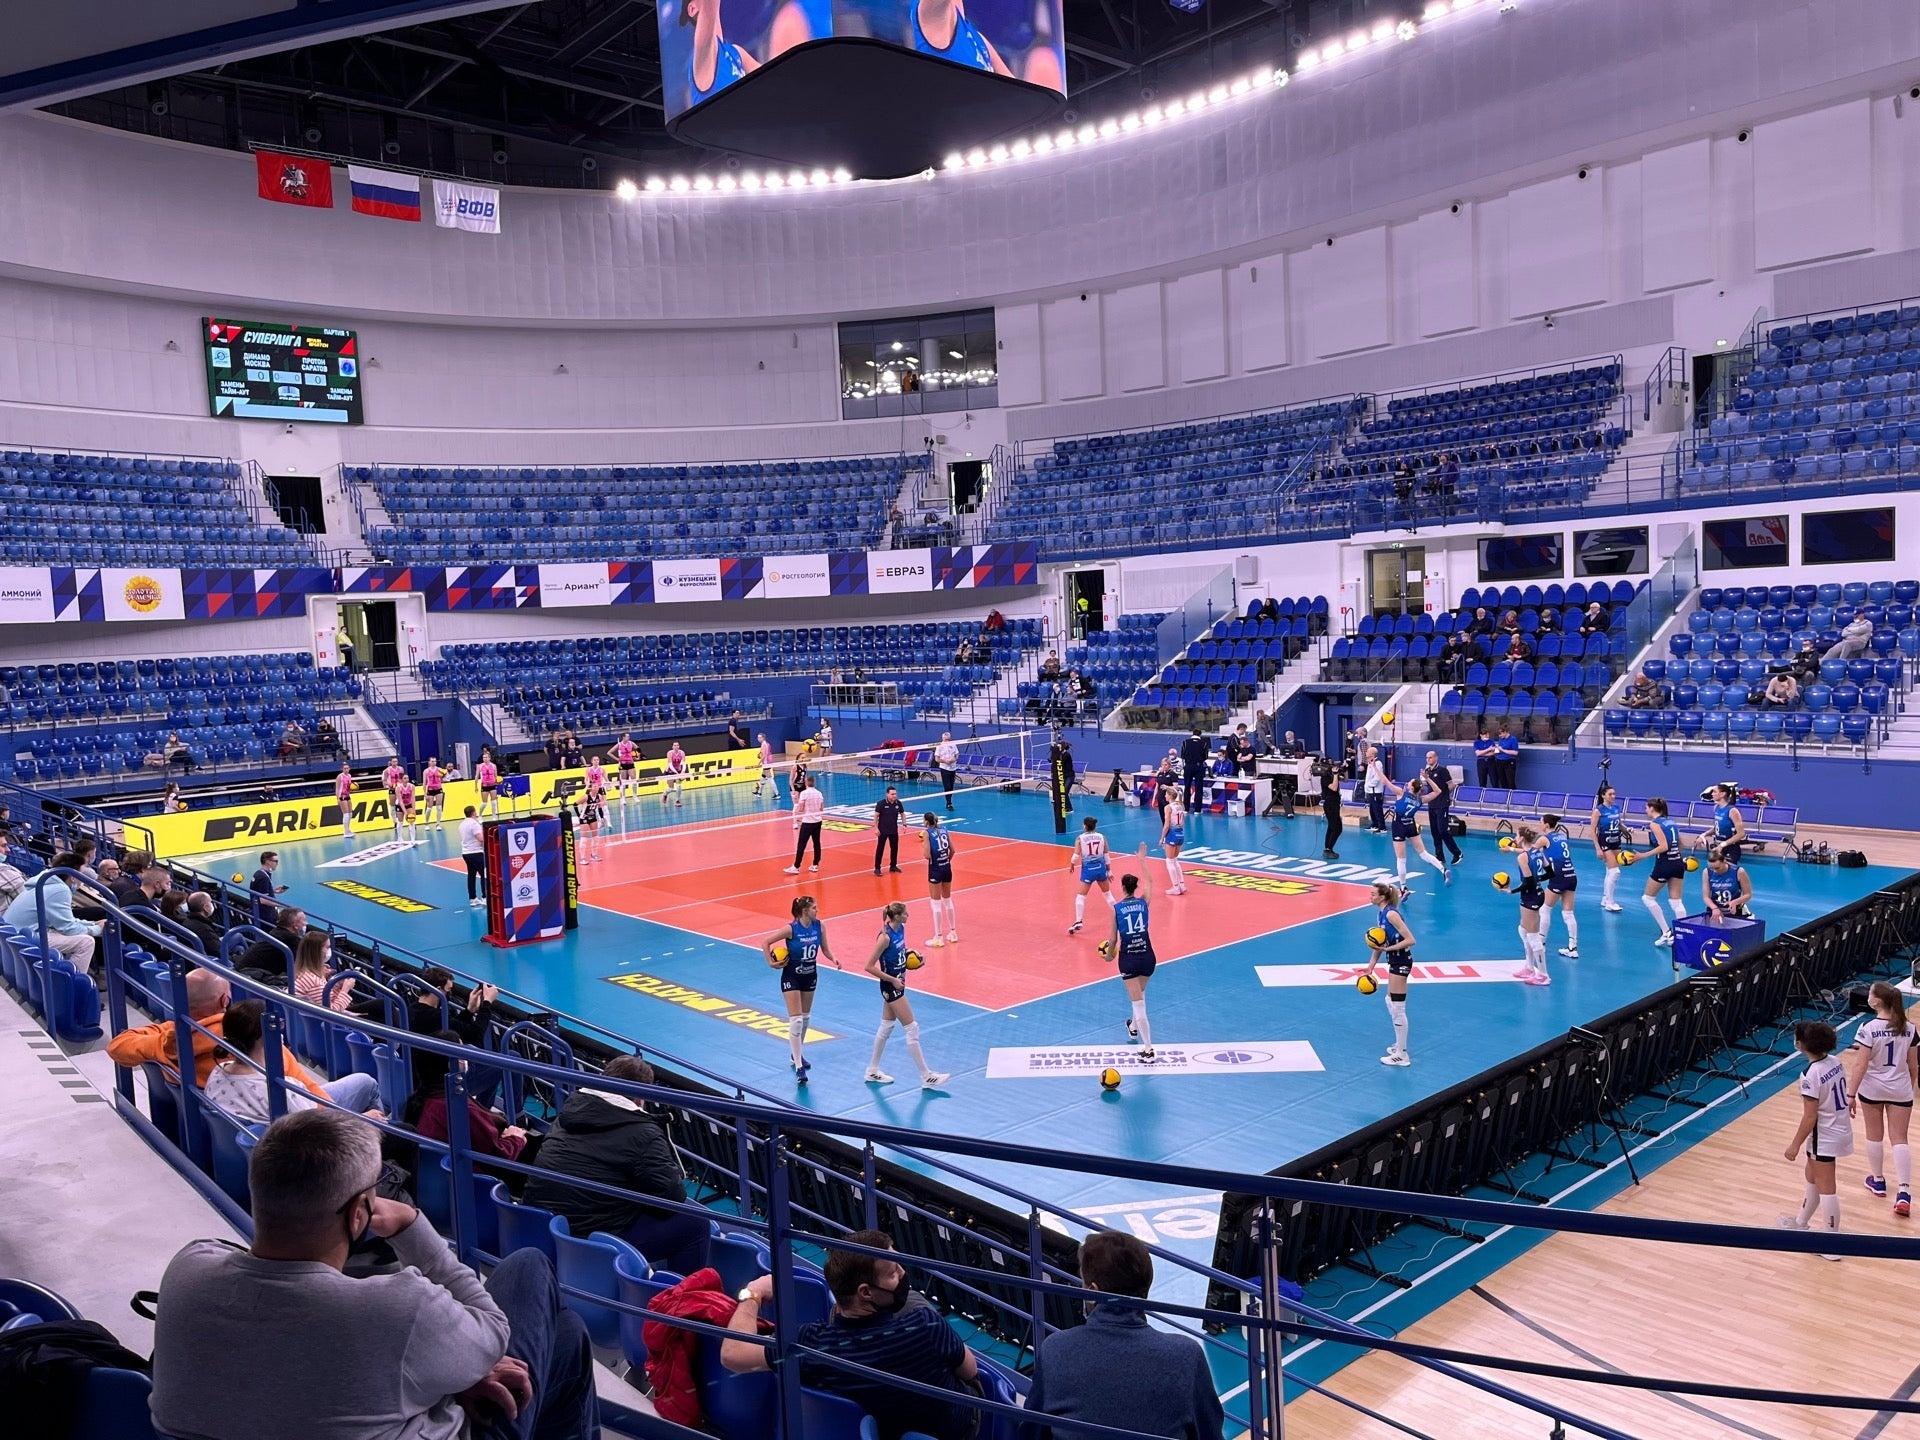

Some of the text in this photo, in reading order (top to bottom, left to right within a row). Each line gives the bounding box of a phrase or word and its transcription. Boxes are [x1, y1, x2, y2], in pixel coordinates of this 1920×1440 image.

[457, 198, 494, 217] ВФВ
[243, 331, 302, 347] СУПЕРЛИГА
[324, 328, 345, 336] ПАРТИЯ
[243, 353, 270, 361] ДИНАМО
[244, 360, 270, 368] МОСКВА
[302, 357, 326, 366] ПРОТОН
[302, 364, 328, 372] САРАТОВ
[258, 371, 265, 380] 0
[314, 376, 321, 384] 0
[220, 387, 249, 396] ТАЙМ-АУТ
[327, 394, 353, 402] ТАЙМ-АУТ
[782, 572, 826, 580] РОСГЕОЛОГИЯ
[886, 566, 925, 577] ЕВРАЗ
[1, 589, 42, 597] АММОНИЙ
[564, 581, 600, 591] Ариант
[1056, 759, 1066, 792] MATCH
[1405, 804, 1415, 816] 7
[204, 808, 308, 842] PARI
[1609, 820, 1619, 830] 12
[1670, 827, 1677, 843] 1
[936, 834, 949, 851] 18
[1087, 842, 1100, 856] 17
[1561, 842, 1569, 858] 3
[564, 830, 576, 909] PARI MATCH
[1178, 846, 1425, 884] МОСКВА
[1537, 859, 1546, 876] 2
[1715, 890, 1731, 906] 19
[1124, 912, 1146, 934] 14
[801, 944, 816, 960] 16
[608, 974, 835, 1044] PARI MATCH
[1883, 1040, 1896, 1067] 1
[1030, 1057, 1188, 1066] КУНЕЦКИЕ
[1832, 1077, 1848, 1111] 10
